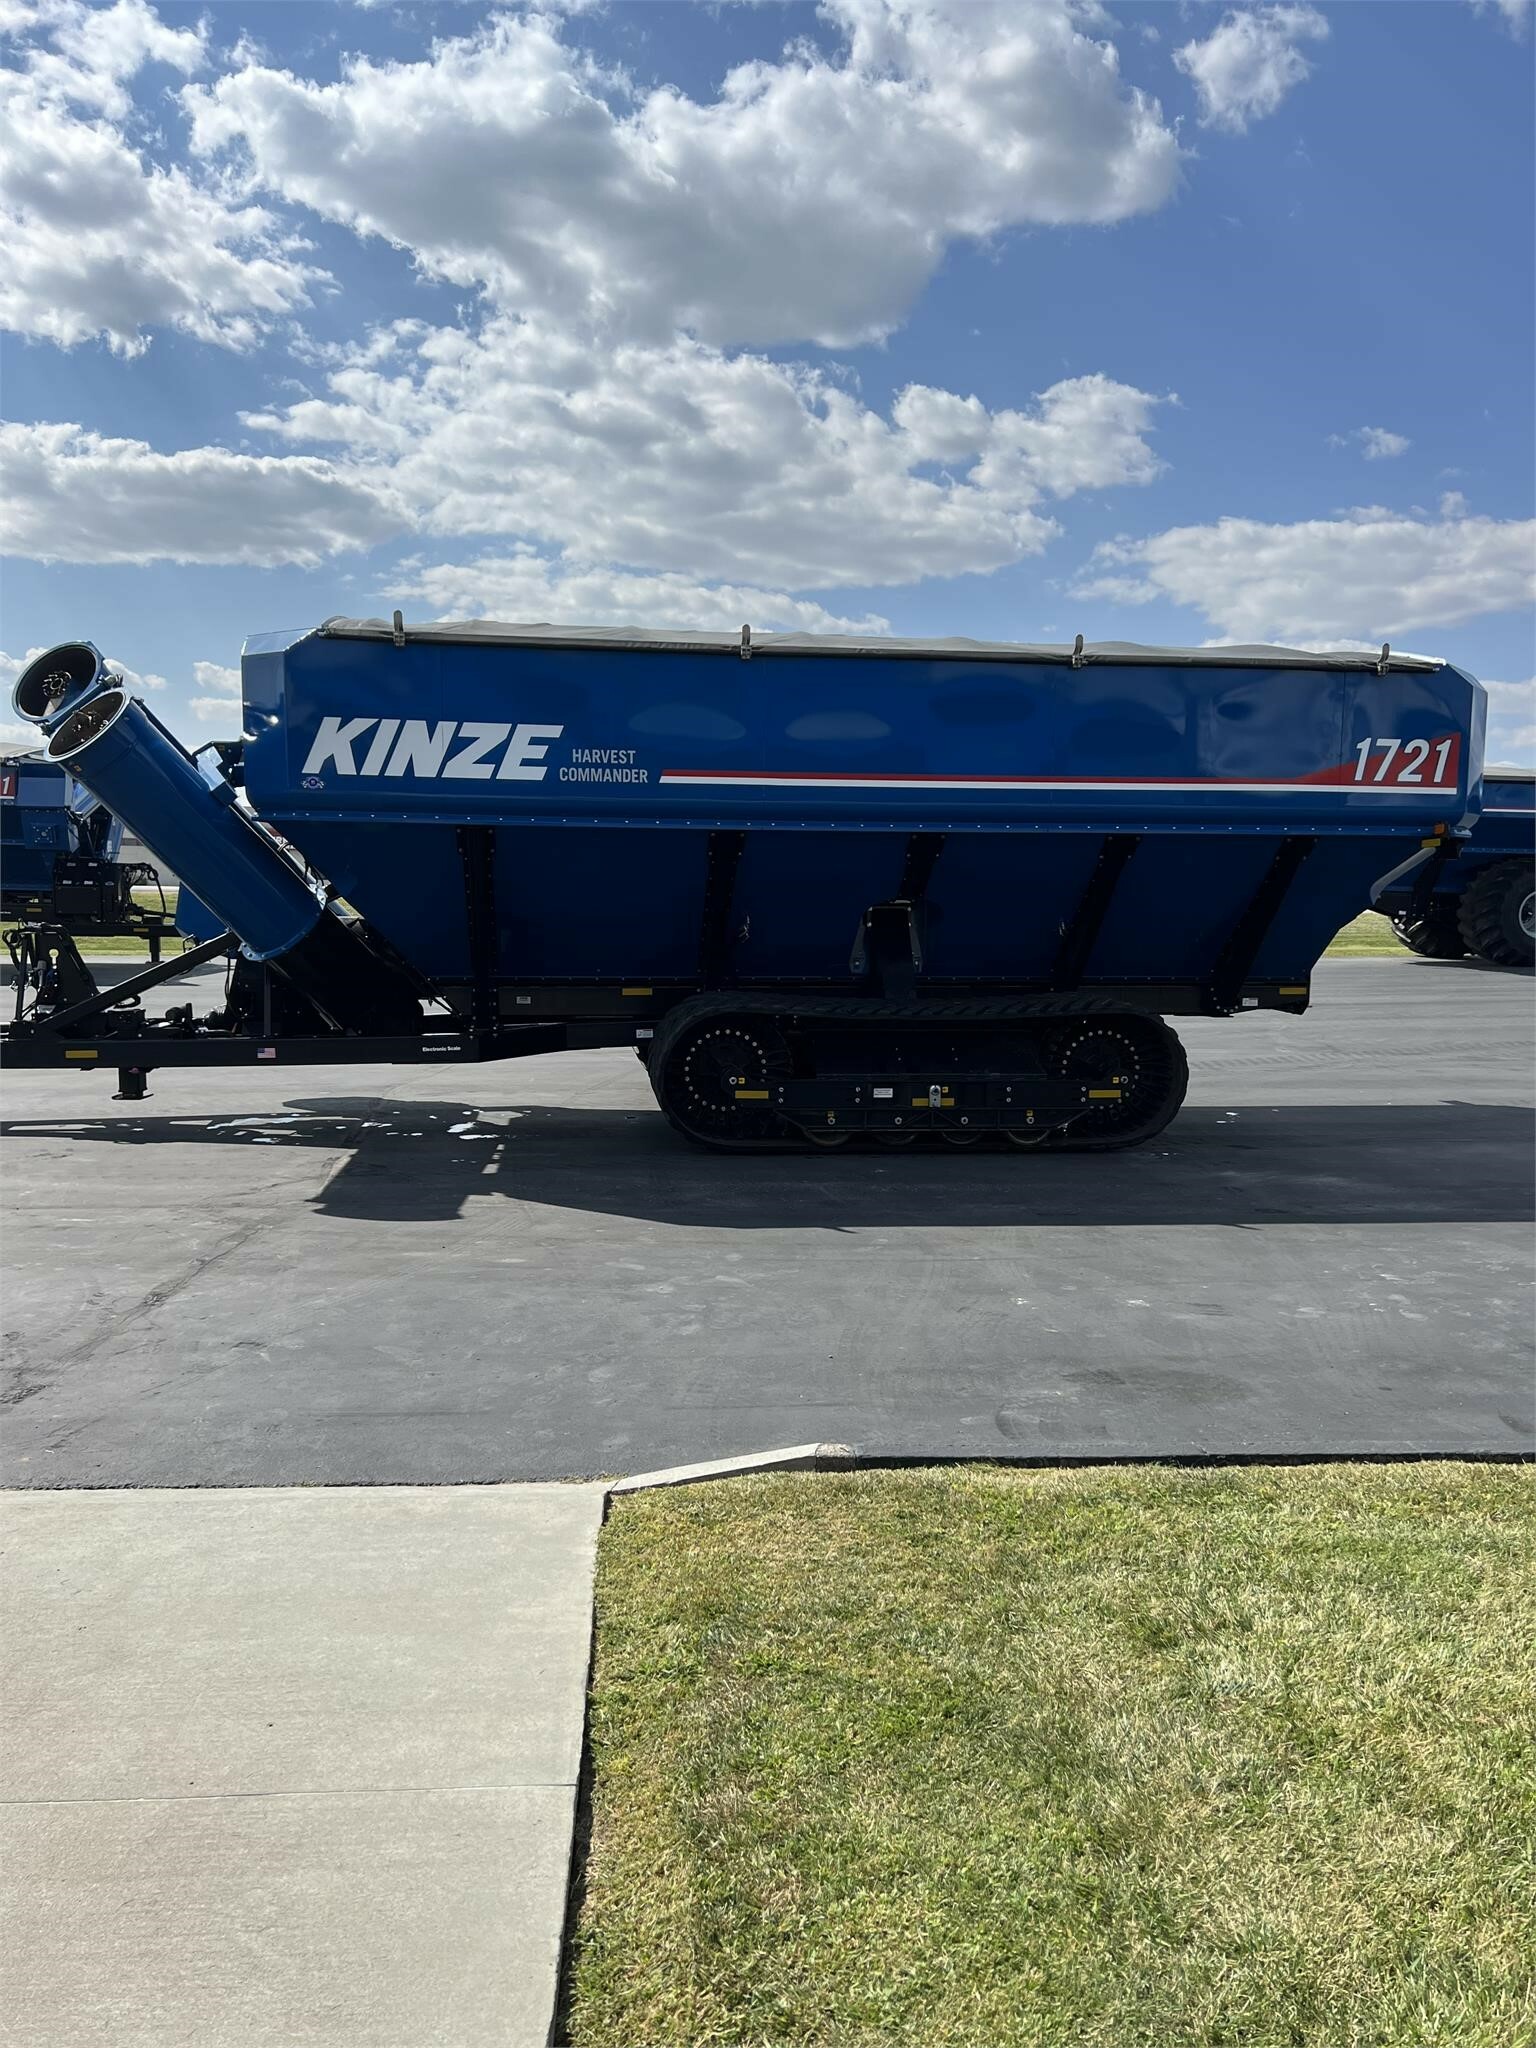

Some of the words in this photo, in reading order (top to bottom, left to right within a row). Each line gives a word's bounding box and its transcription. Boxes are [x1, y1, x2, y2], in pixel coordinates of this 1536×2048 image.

[301, 716, 564, 781] KINZE
[572, 748, 636, 764] HARVEST
[1354, 737, 1452, 783] 1721
[559, 767, 648, 784] COMMANDER
